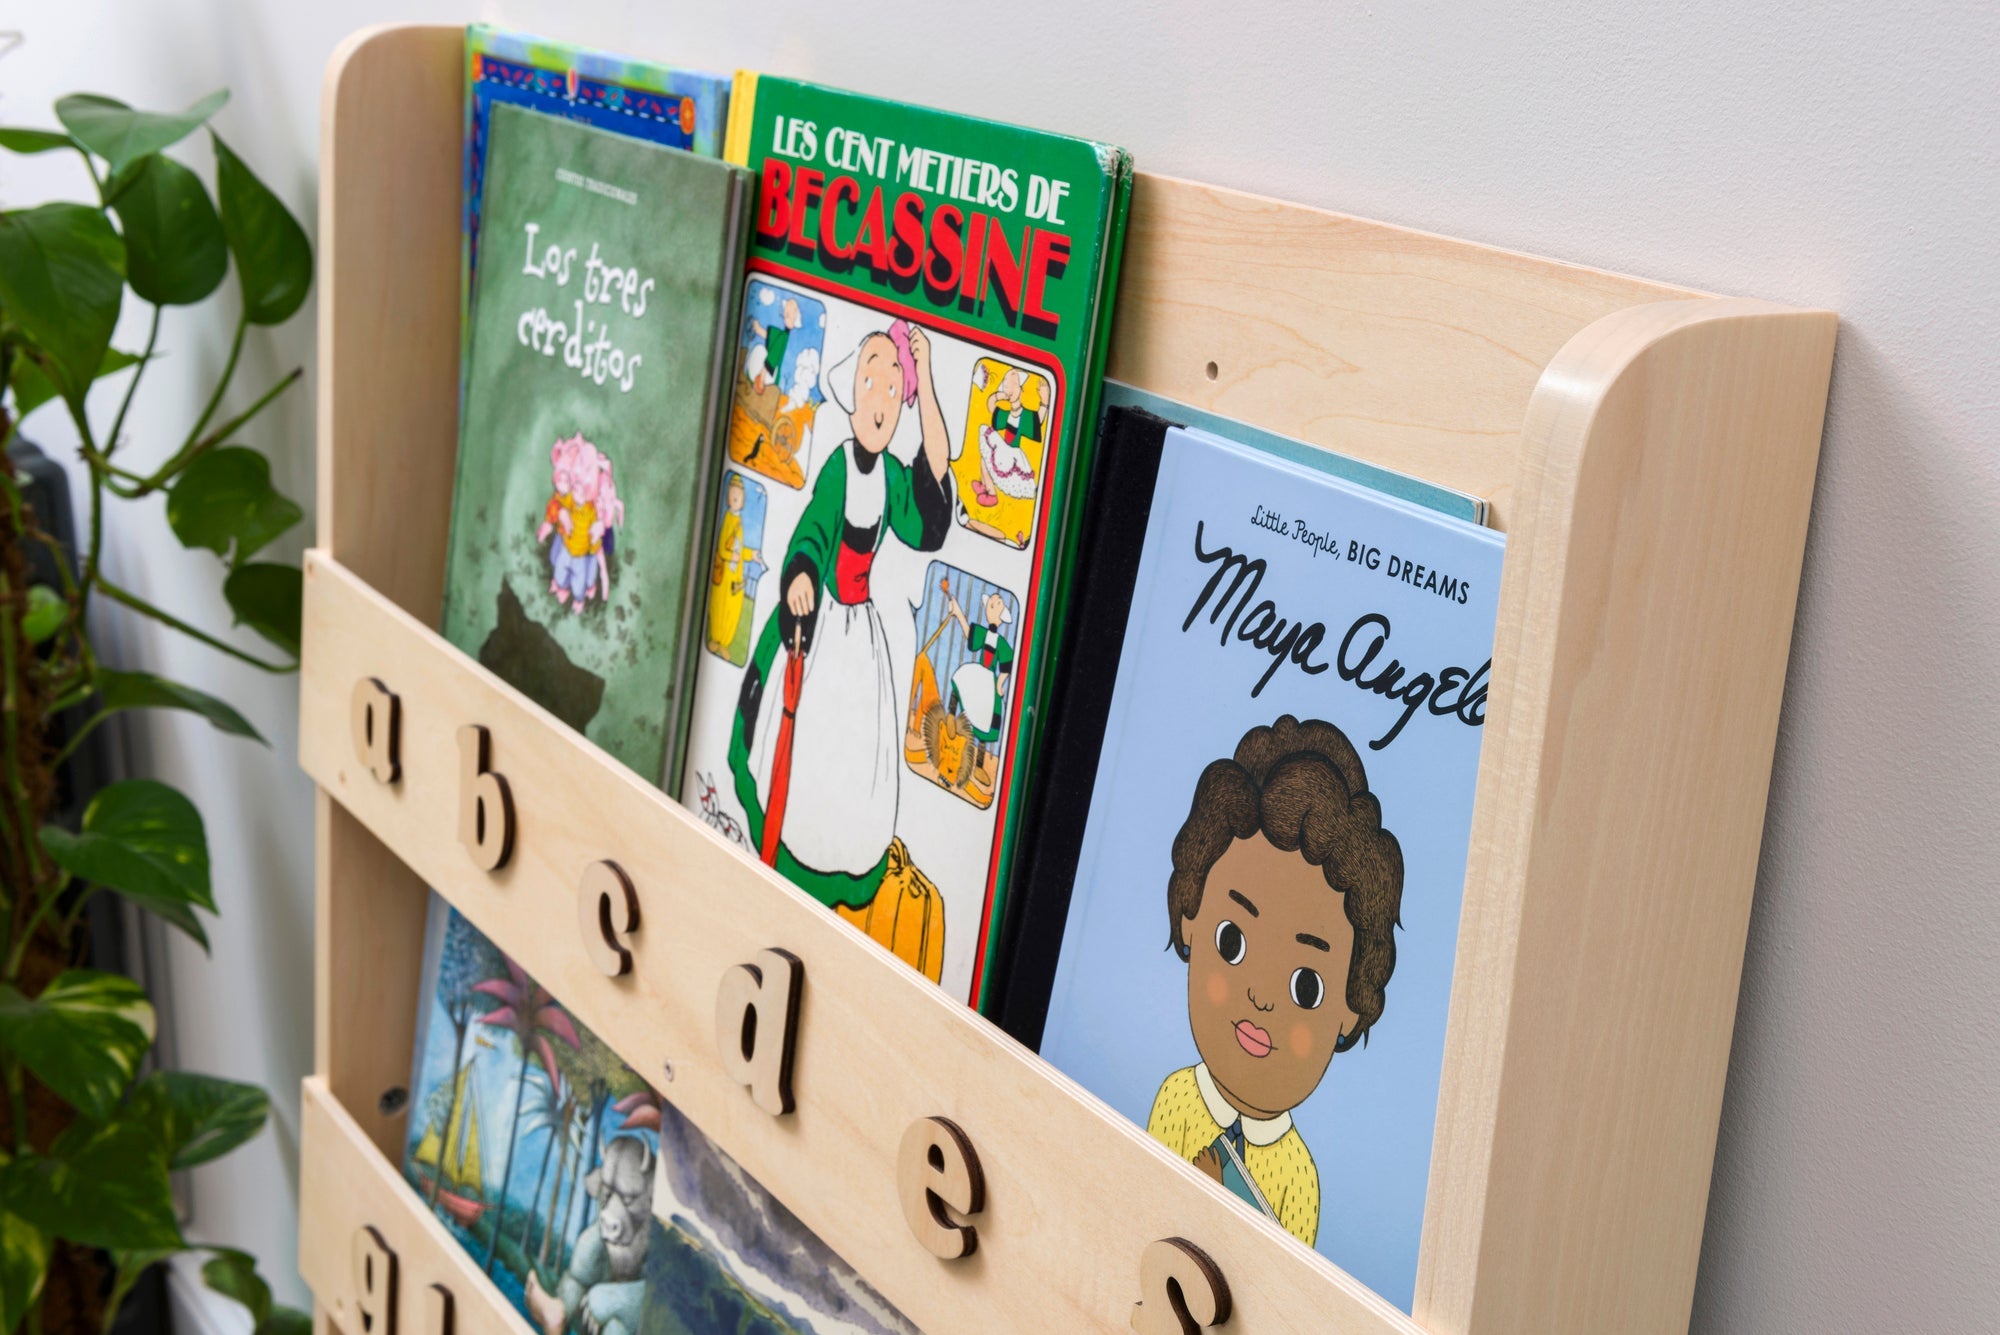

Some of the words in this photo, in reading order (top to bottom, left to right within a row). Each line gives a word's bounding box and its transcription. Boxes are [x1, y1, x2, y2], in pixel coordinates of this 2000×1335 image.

[772, 115, 817, 161] LES
[824, 126, 895, 179] CENT
[896, 143, 1018, 213] METIERS
[1025, 174, 1070, 225] DE
[522, 222, 577, 286] Los
[584, 242, 655, 318] tres
[756, 157, 1071, 341] BECASSINE
[517, 299, 642, 392] cerditos
[1182, 520, 1329, 699] Maya
[1250, 505, 1289, 536] Little
[1292, 519, 1340, 560] People,
[1347, 540, 1380, 570] BIG
[1387, 555, 1470, 605] DREAMS
[350, 677, 403, 785] a
[456, 724, 516, 872] b
[578, 859, 642, 979] c
[715, 947, 803, 1117] d
[897, 1115, 987, 1260] e
